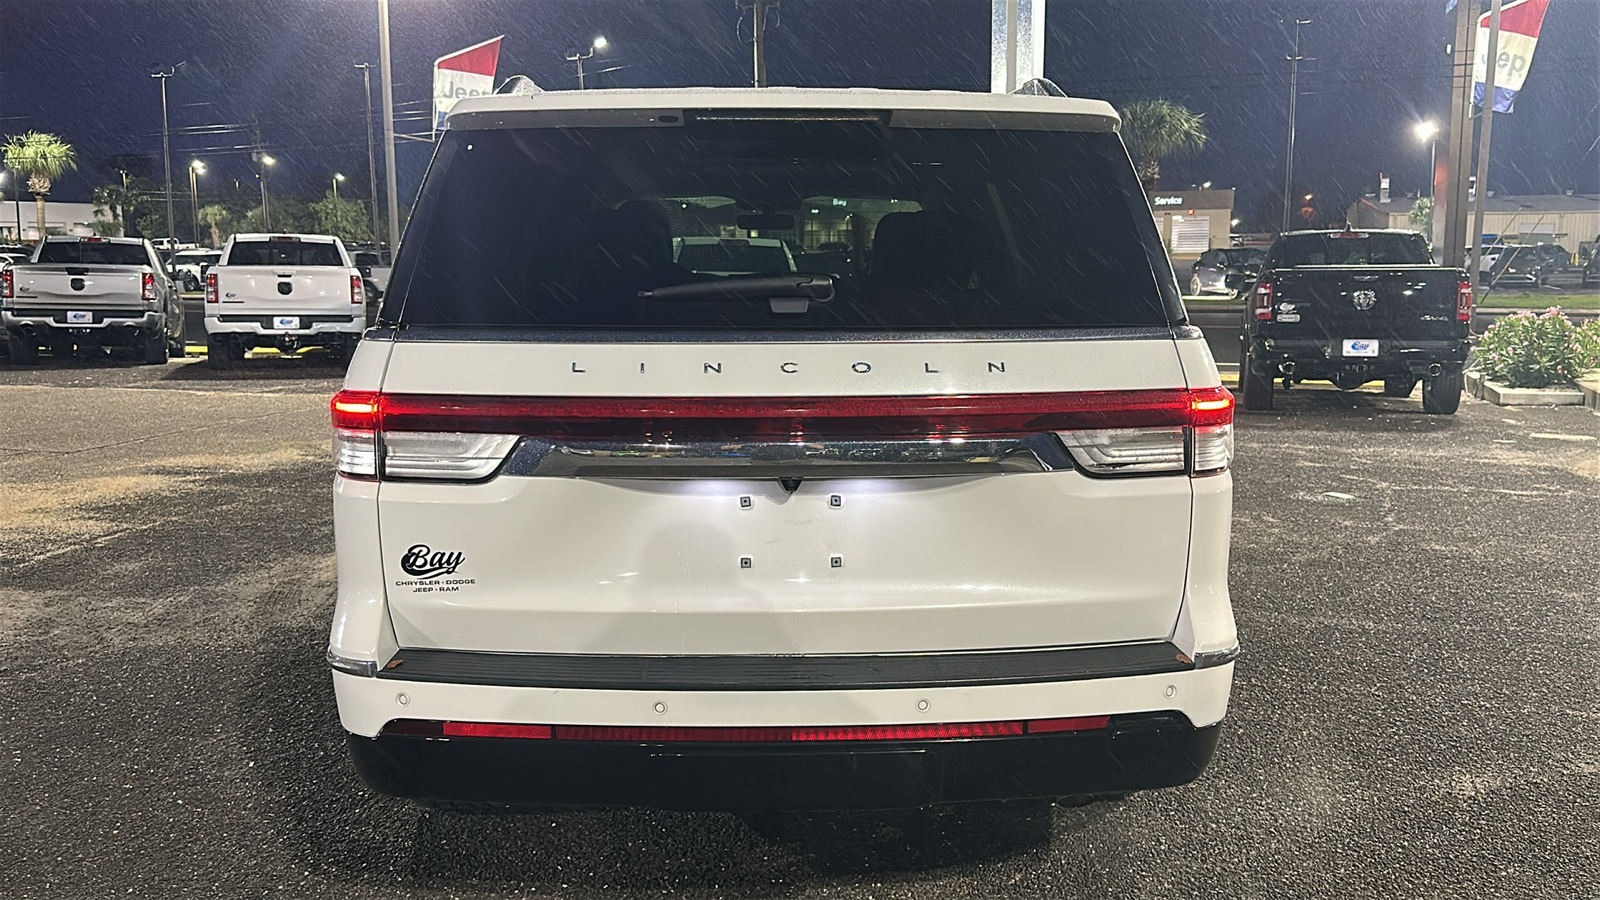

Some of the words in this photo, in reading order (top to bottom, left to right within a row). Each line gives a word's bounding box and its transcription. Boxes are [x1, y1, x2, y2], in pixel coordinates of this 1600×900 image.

[832, 198, 847, 207] Bay
[1154, 196, 1183, 206] Service
[571, 361, 1006, 375] LINCOLN
[401, 544, 466, 580] Bay
